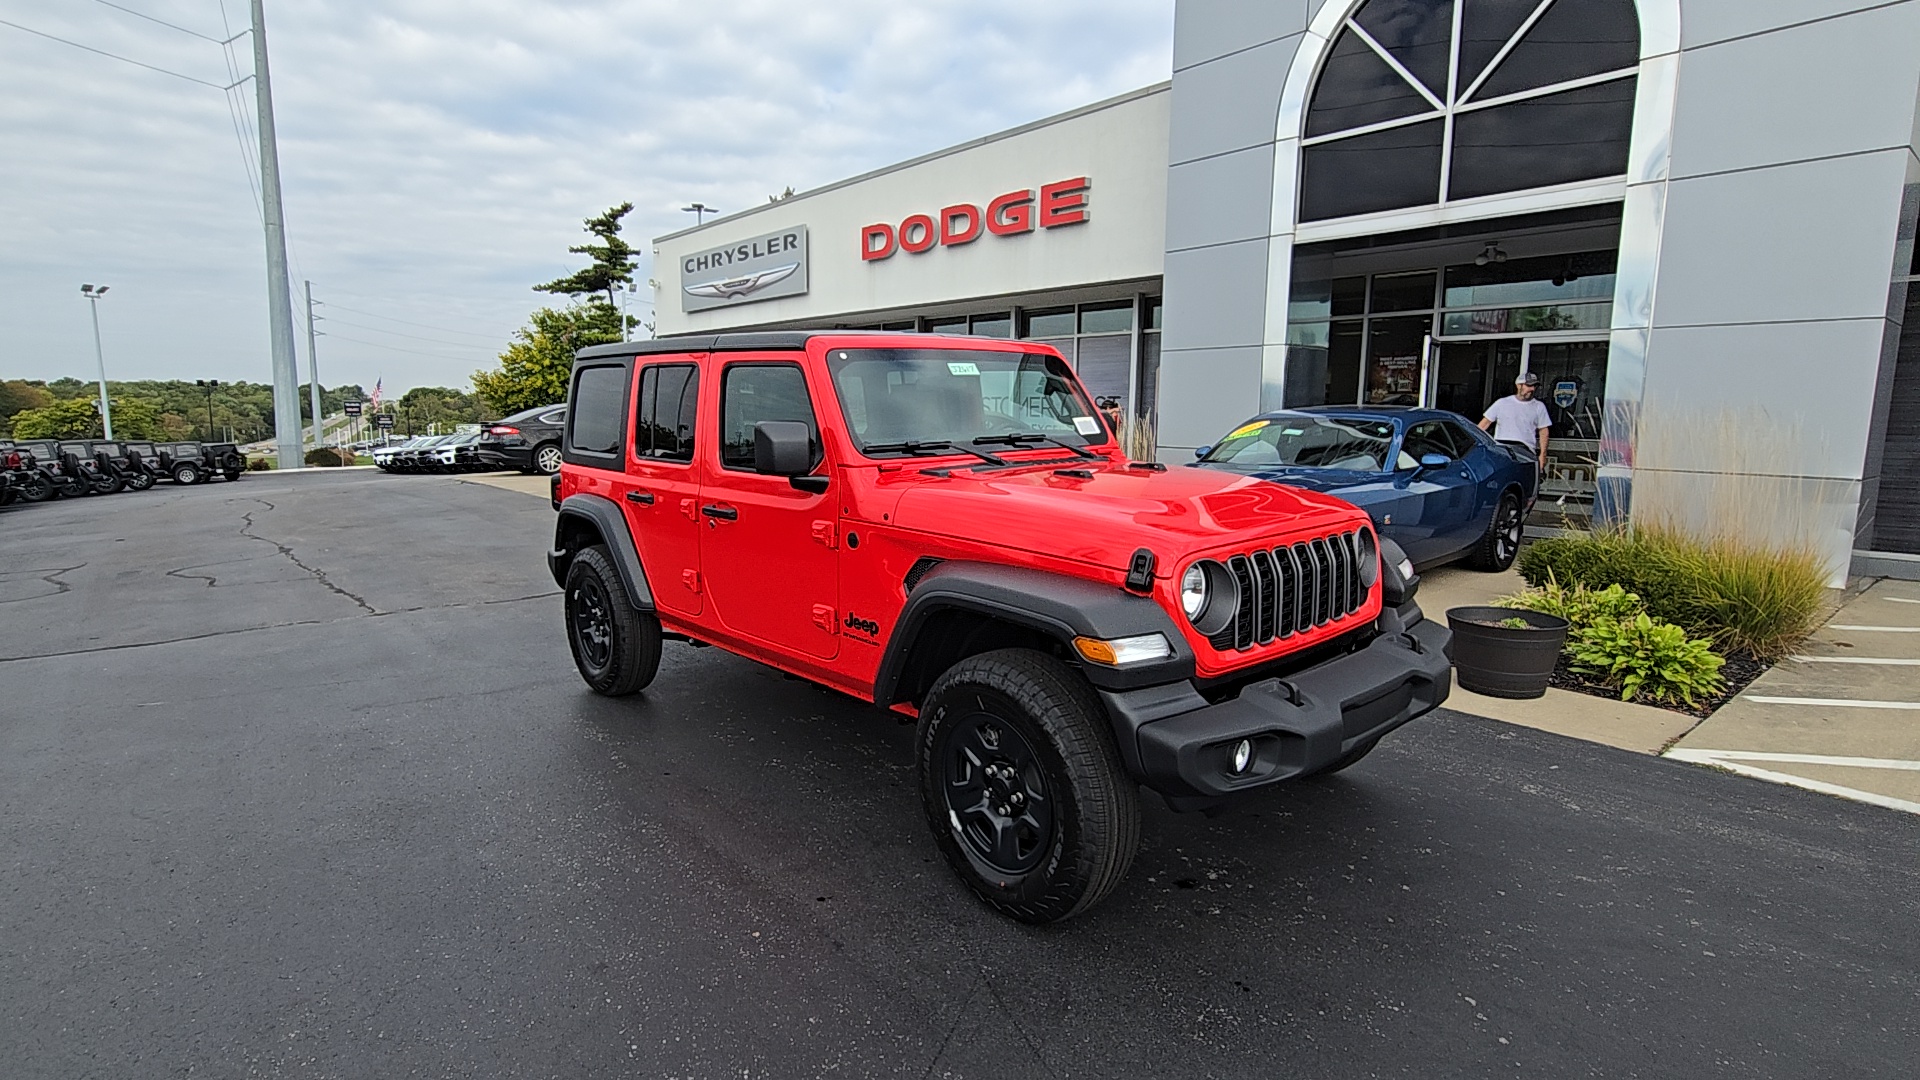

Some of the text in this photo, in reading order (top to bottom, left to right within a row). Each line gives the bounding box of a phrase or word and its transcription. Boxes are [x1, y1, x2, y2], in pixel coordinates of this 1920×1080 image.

[862, 177, 1090, 261] DODGE
[684, 233, 798, 274] CHRYSLER
[982, 396, 1054, 418] STOMER
[844, 611, 879, 638] Jeep
